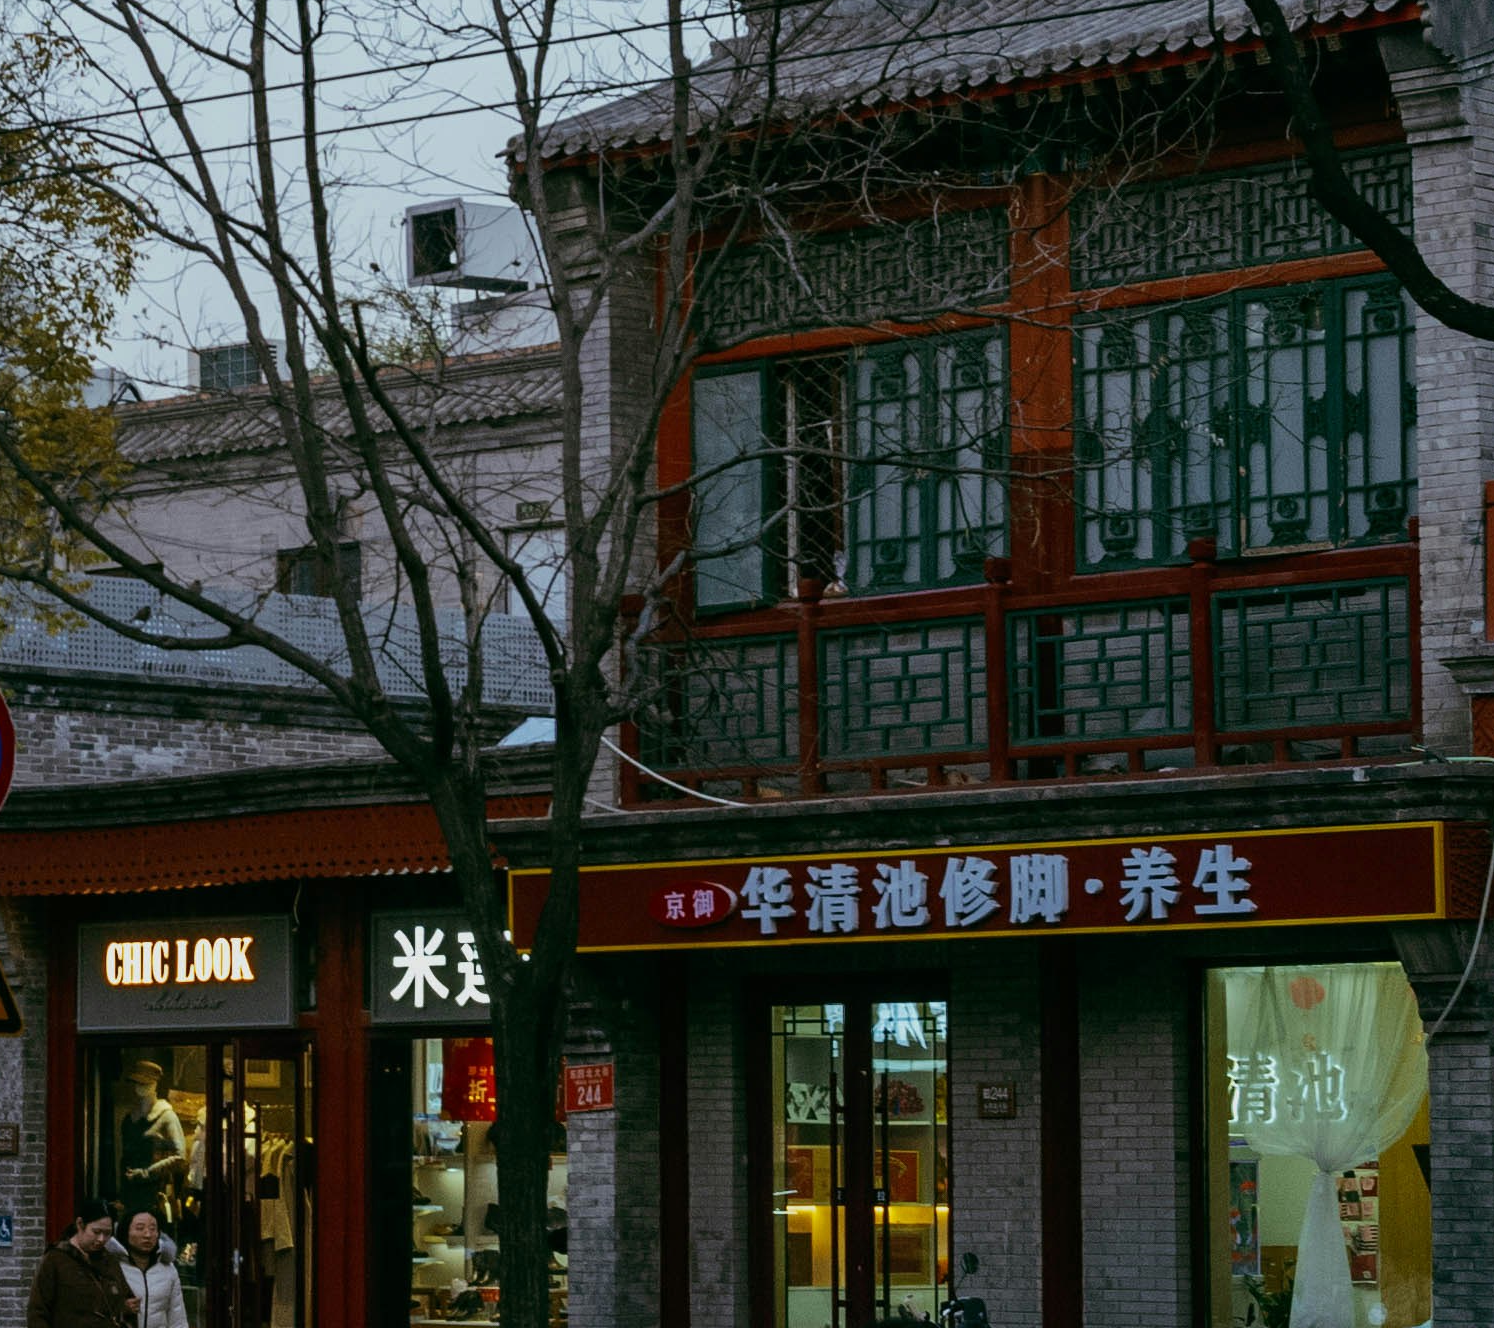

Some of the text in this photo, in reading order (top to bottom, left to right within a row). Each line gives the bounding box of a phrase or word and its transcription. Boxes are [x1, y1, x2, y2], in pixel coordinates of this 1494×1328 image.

[664, 889, 715, 920] 京御
[106, 936, 255, 986] CHIC LOOK
[577, 1084, 603, 1106] 244
